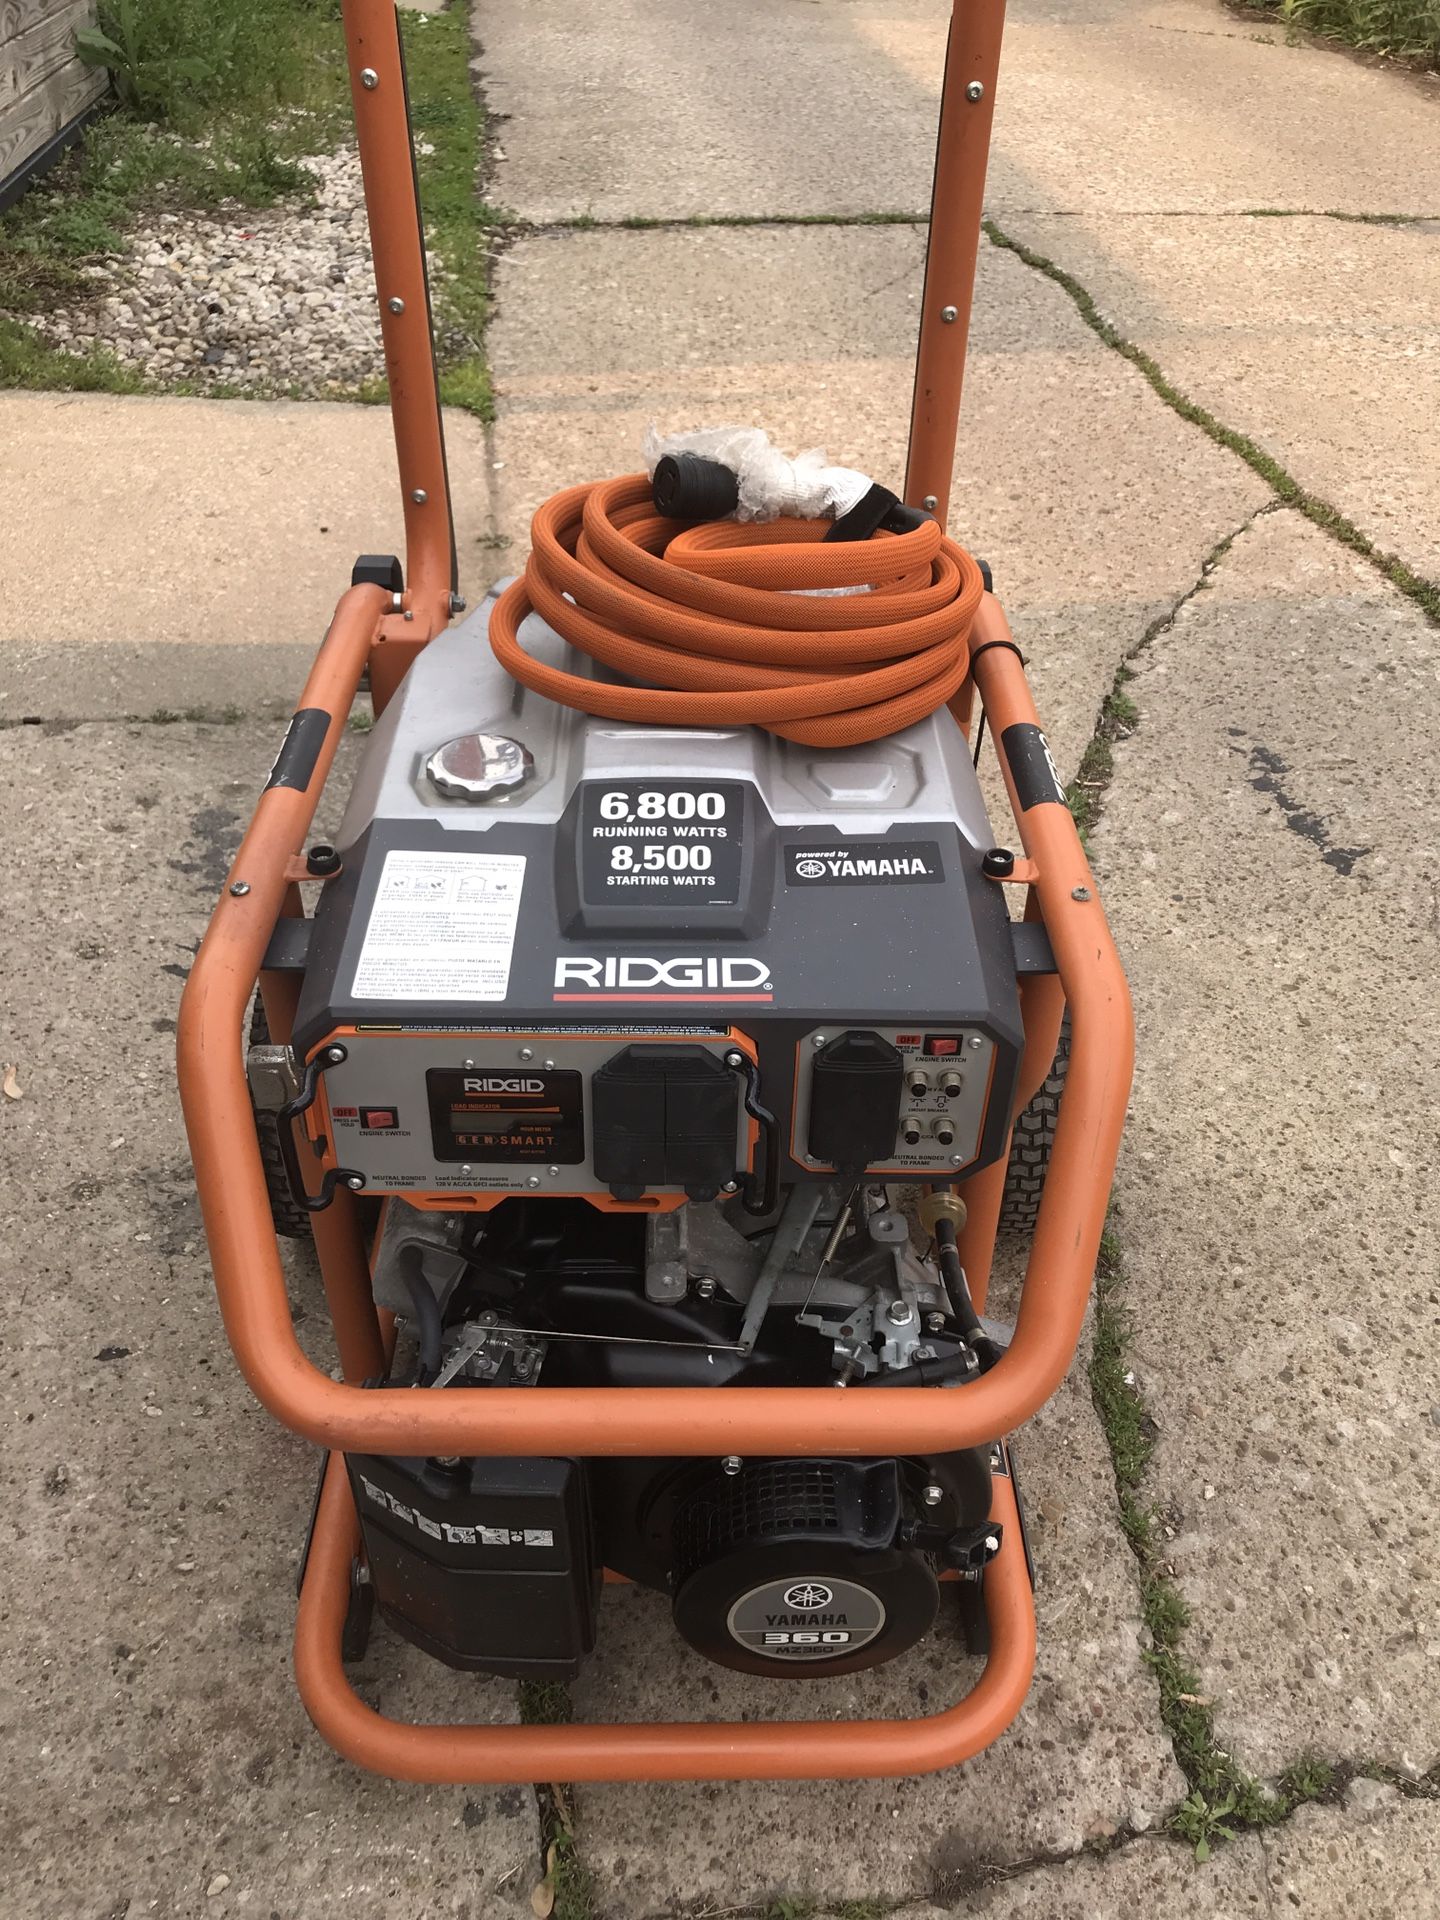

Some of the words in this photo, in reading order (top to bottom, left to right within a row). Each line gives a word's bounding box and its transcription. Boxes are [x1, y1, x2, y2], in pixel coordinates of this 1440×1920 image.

[600, 792, 725, 822] 6,800
[593, 827, 667, 837] RUNNING
[673, 827, 727, 837] WATTS
[611, 845, 711, 873] 8,500
[795, 851, 835, 859] powered
[827, 858, 927, 876] YAMAHA
[607, 876, 669, 885] STARTING
[673, 876, 716, 885] WATTS
[554, 957, 771, 988] RIDGID
[464, 1078, 545, 1092] RIDGID
[766, 1614, 848, 1626] YAMAHA
[764, 1631, 850, 1644] 360
